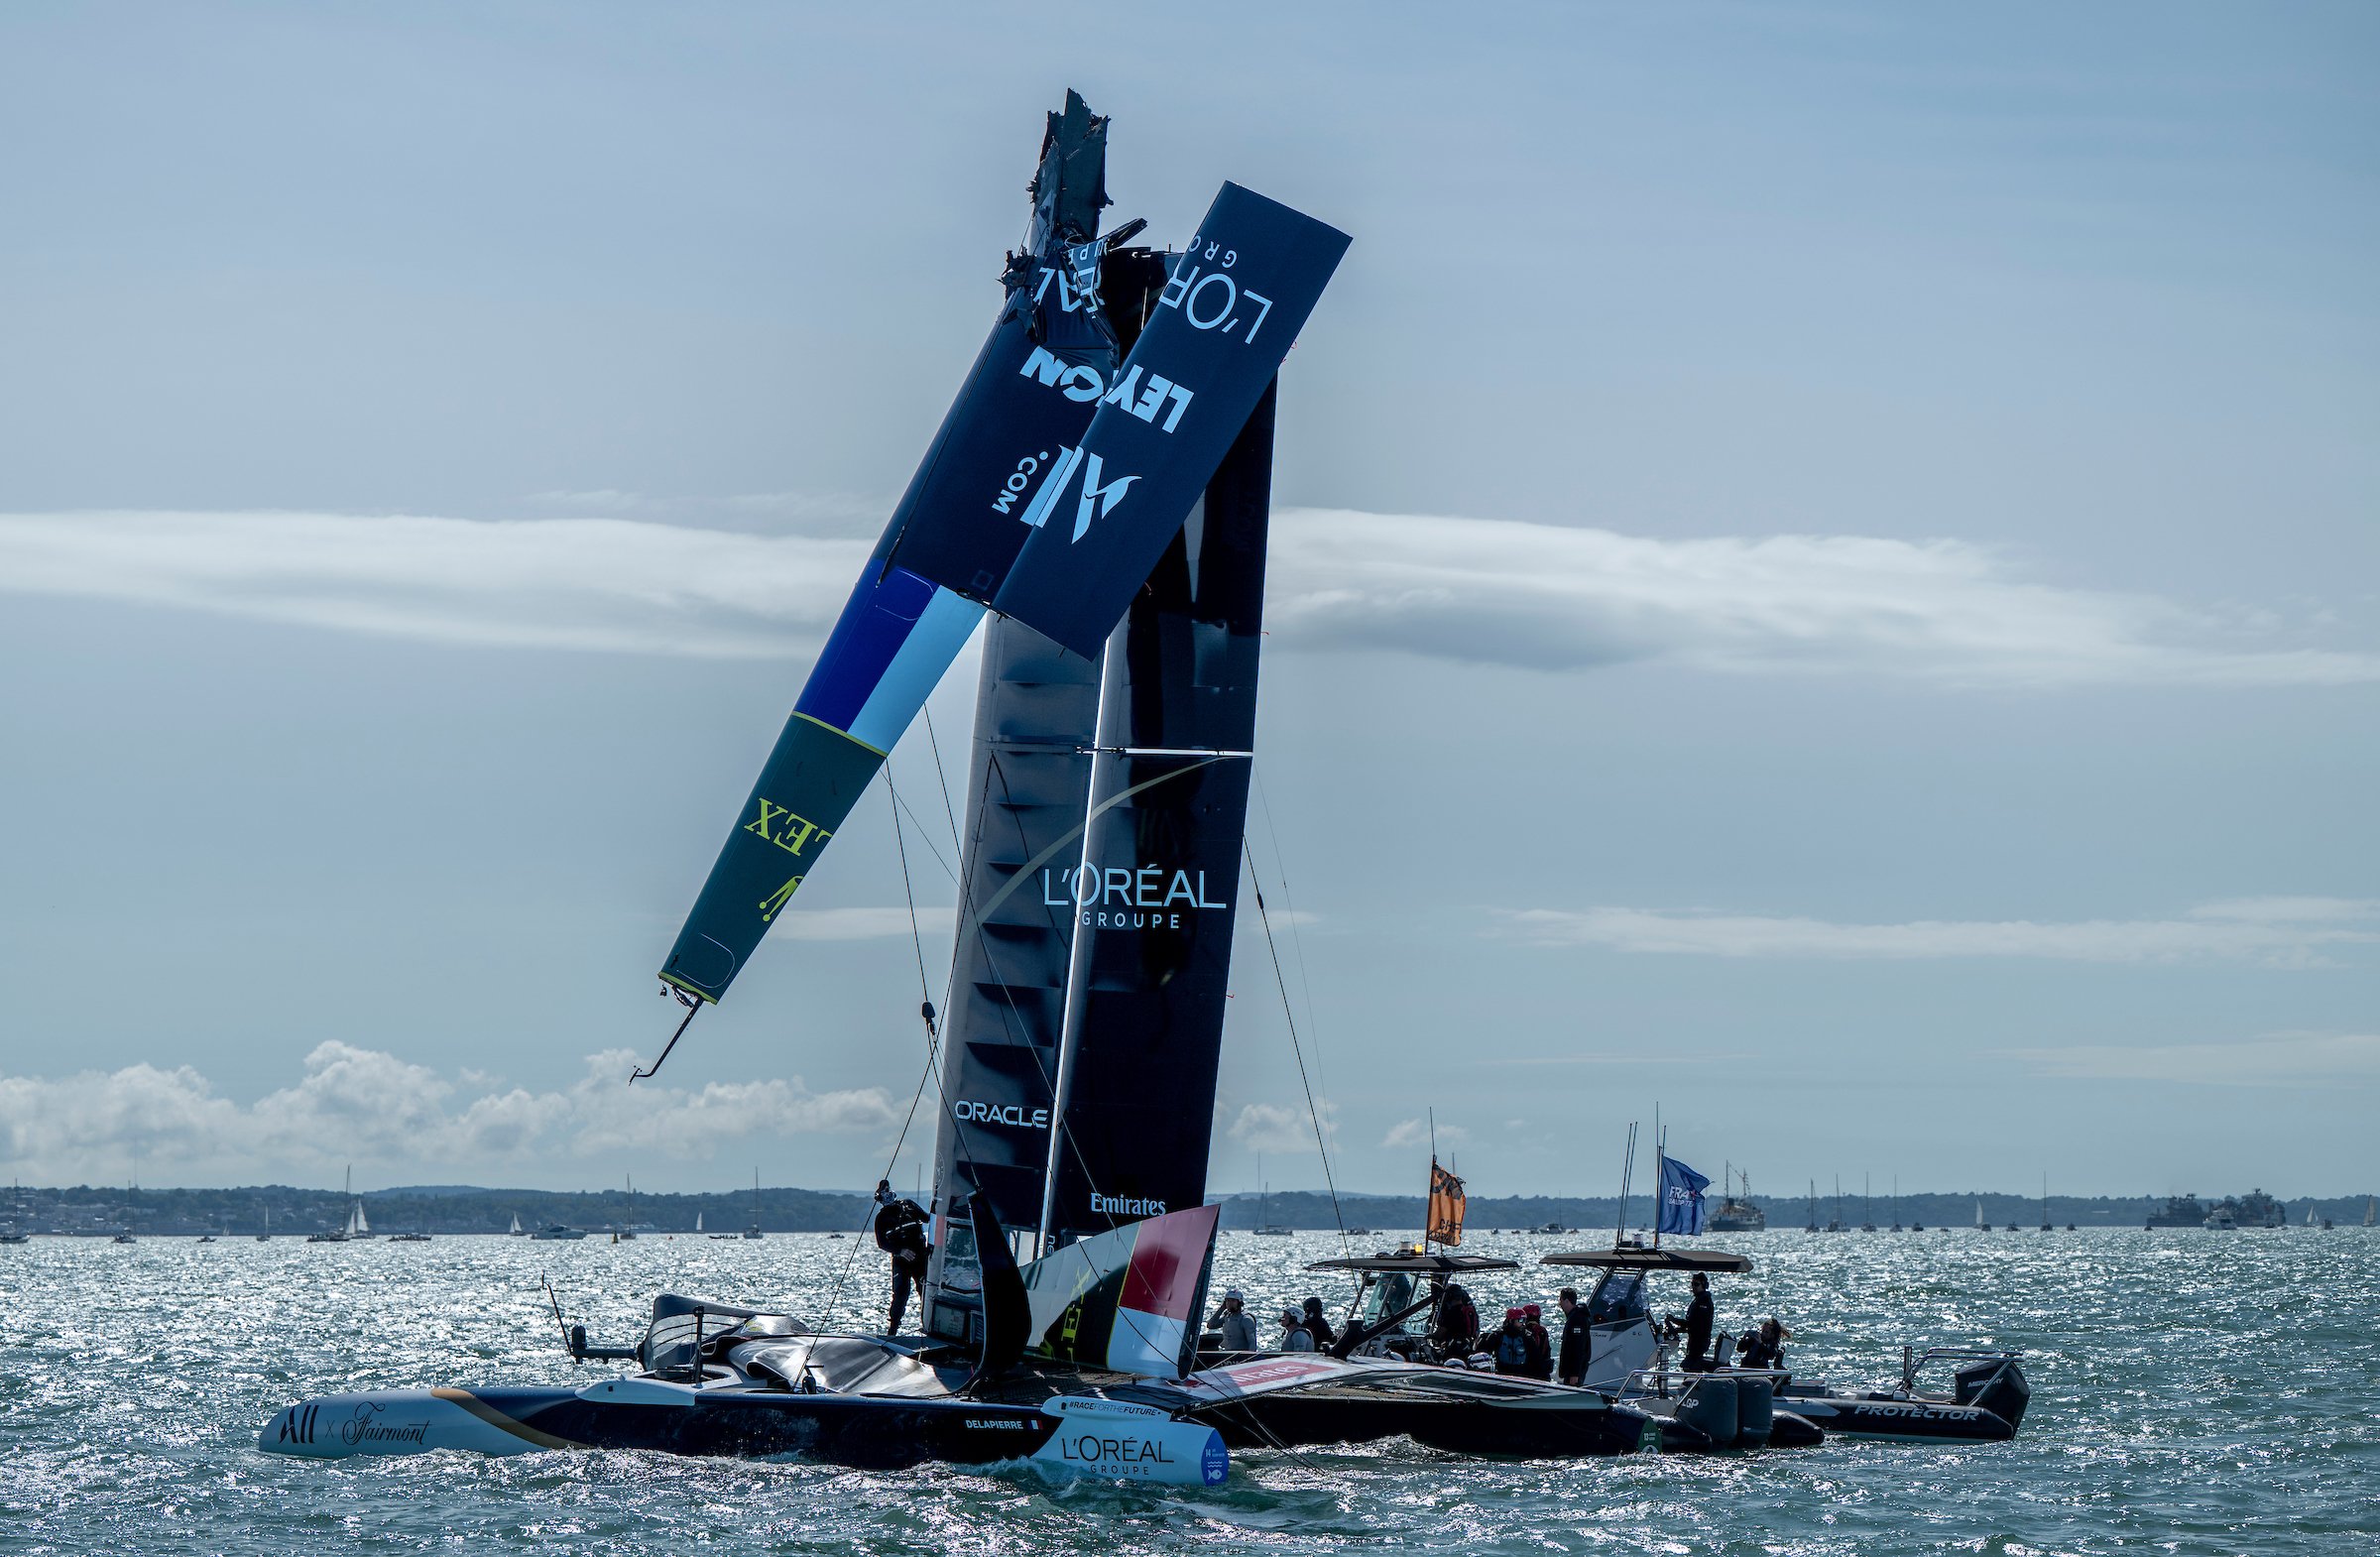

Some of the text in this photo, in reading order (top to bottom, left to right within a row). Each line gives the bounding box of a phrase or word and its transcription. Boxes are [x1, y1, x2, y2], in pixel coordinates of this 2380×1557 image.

[744, 797, 833, 857] EX
[1043, 861, 1228, 909] L'ORÉAL
[1082, 910, 1180, 929] GROUPE
[955, 1100, 1048, 1130] ORACLE
[1091, 1192, 1167, 1217] Emirates
[342, 1400, 434, 1446] Fairmont
[965, 1419, 1023, 1430] DELAPIERRE
[1854, 1404, 1979, 1421] PROTECTOR
[1061, 1435, 1175, 1464] L'ORÉAL
[1090, 1465, 1149, 1476] GROUPE
